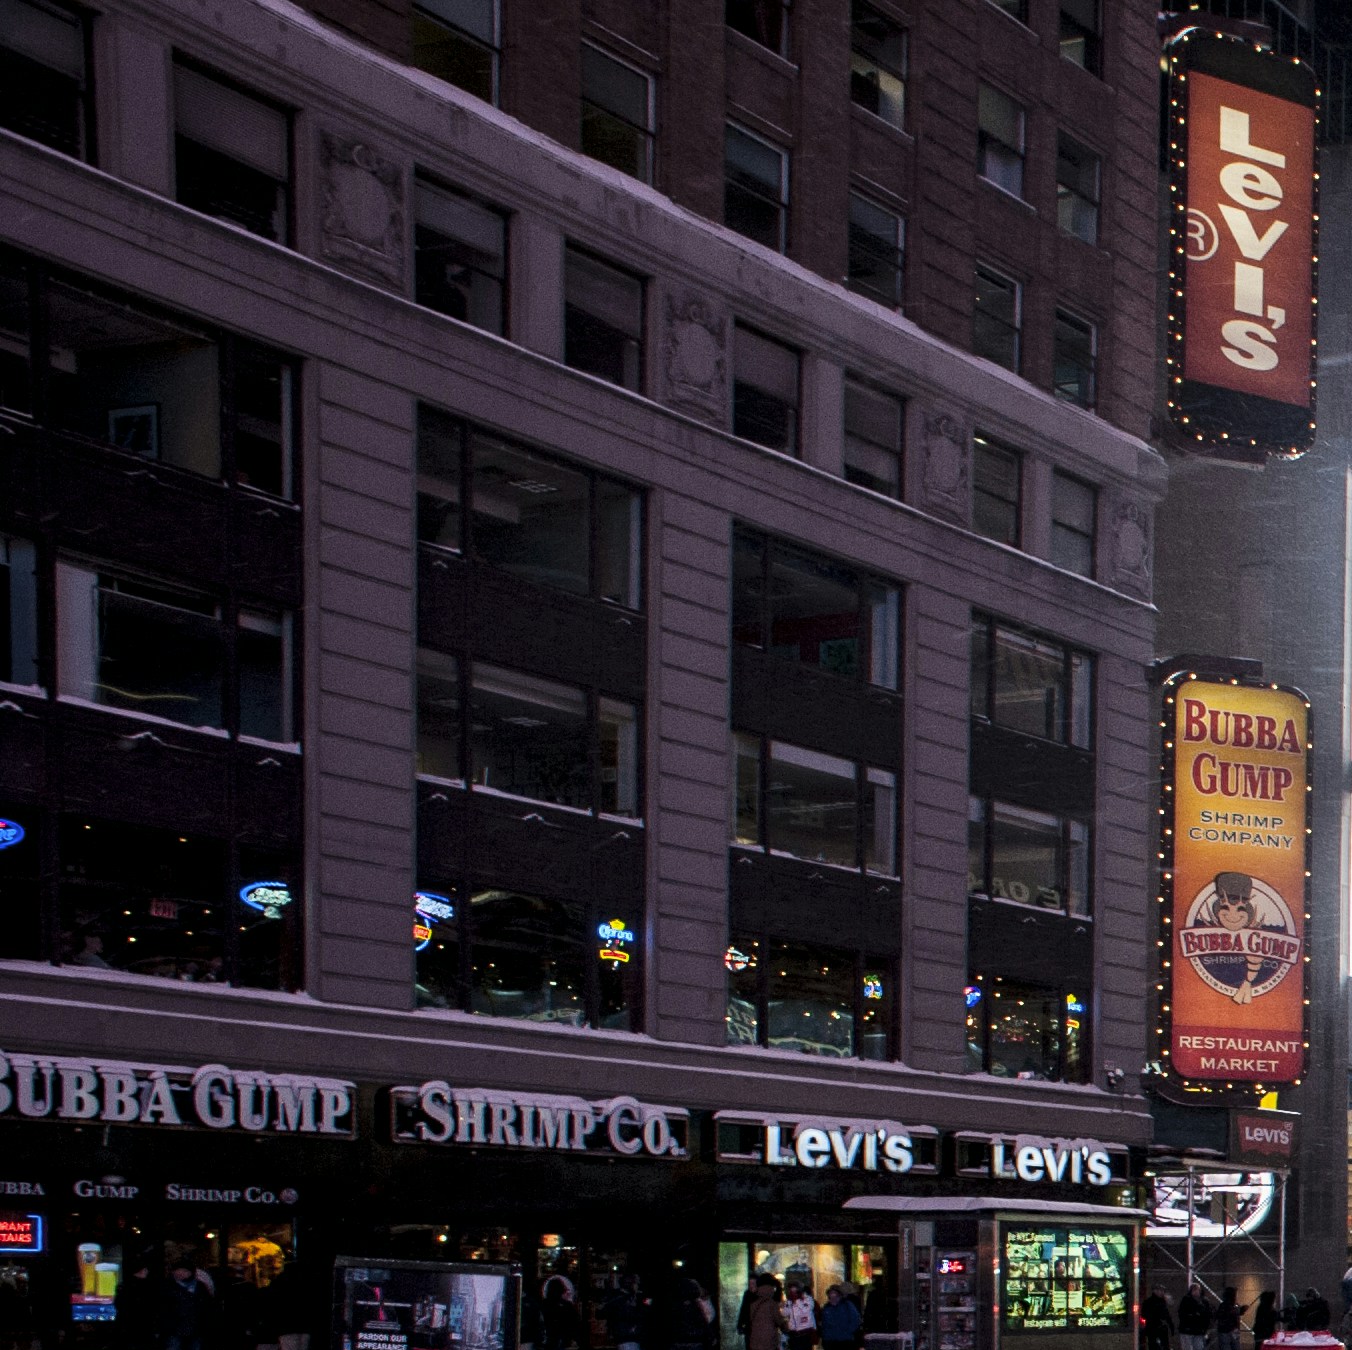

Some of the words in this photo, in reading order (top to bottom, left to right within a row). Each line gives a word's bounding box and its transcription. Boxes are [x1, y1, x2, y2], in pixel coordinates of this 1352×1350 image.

[1218, 106, 1289, 371] Levi's
[1184, 699, 1301, 753] BUBBA
[1192, 752, 1293, 801] GUMP
[1201, 810, 1284, 829] SHRIMP
[1189, 827, 1294, 849] COMPANY
[599, 924, 633, 941] Corona
[1183, 931, 1243, 955] BUBBA
[1247, 932, 1298, 959] GUMP
[1203, 956, 1245, 965] SHRIMP
[1179, 1036, 1300, 1054] RESTAURANT
[1201, 1057, 1279, 1072] MARKET
[194, 1067, 349, 1133] GUMP
[416, 1085, 596, 1150] SHRIMP
[608, 1101, 686, 1156] CO.
[1245, 1126, 1289, 1145] Levi's
[765, 1125, 913, 1173] Levi's
[993, 1144, 1111, 1186] Levi's
[74, 1180, 139, 1199] GUMP
[166, 1183, 241, 1202] SHRIMP
[358, 1332, 389, 1342] PARDON
